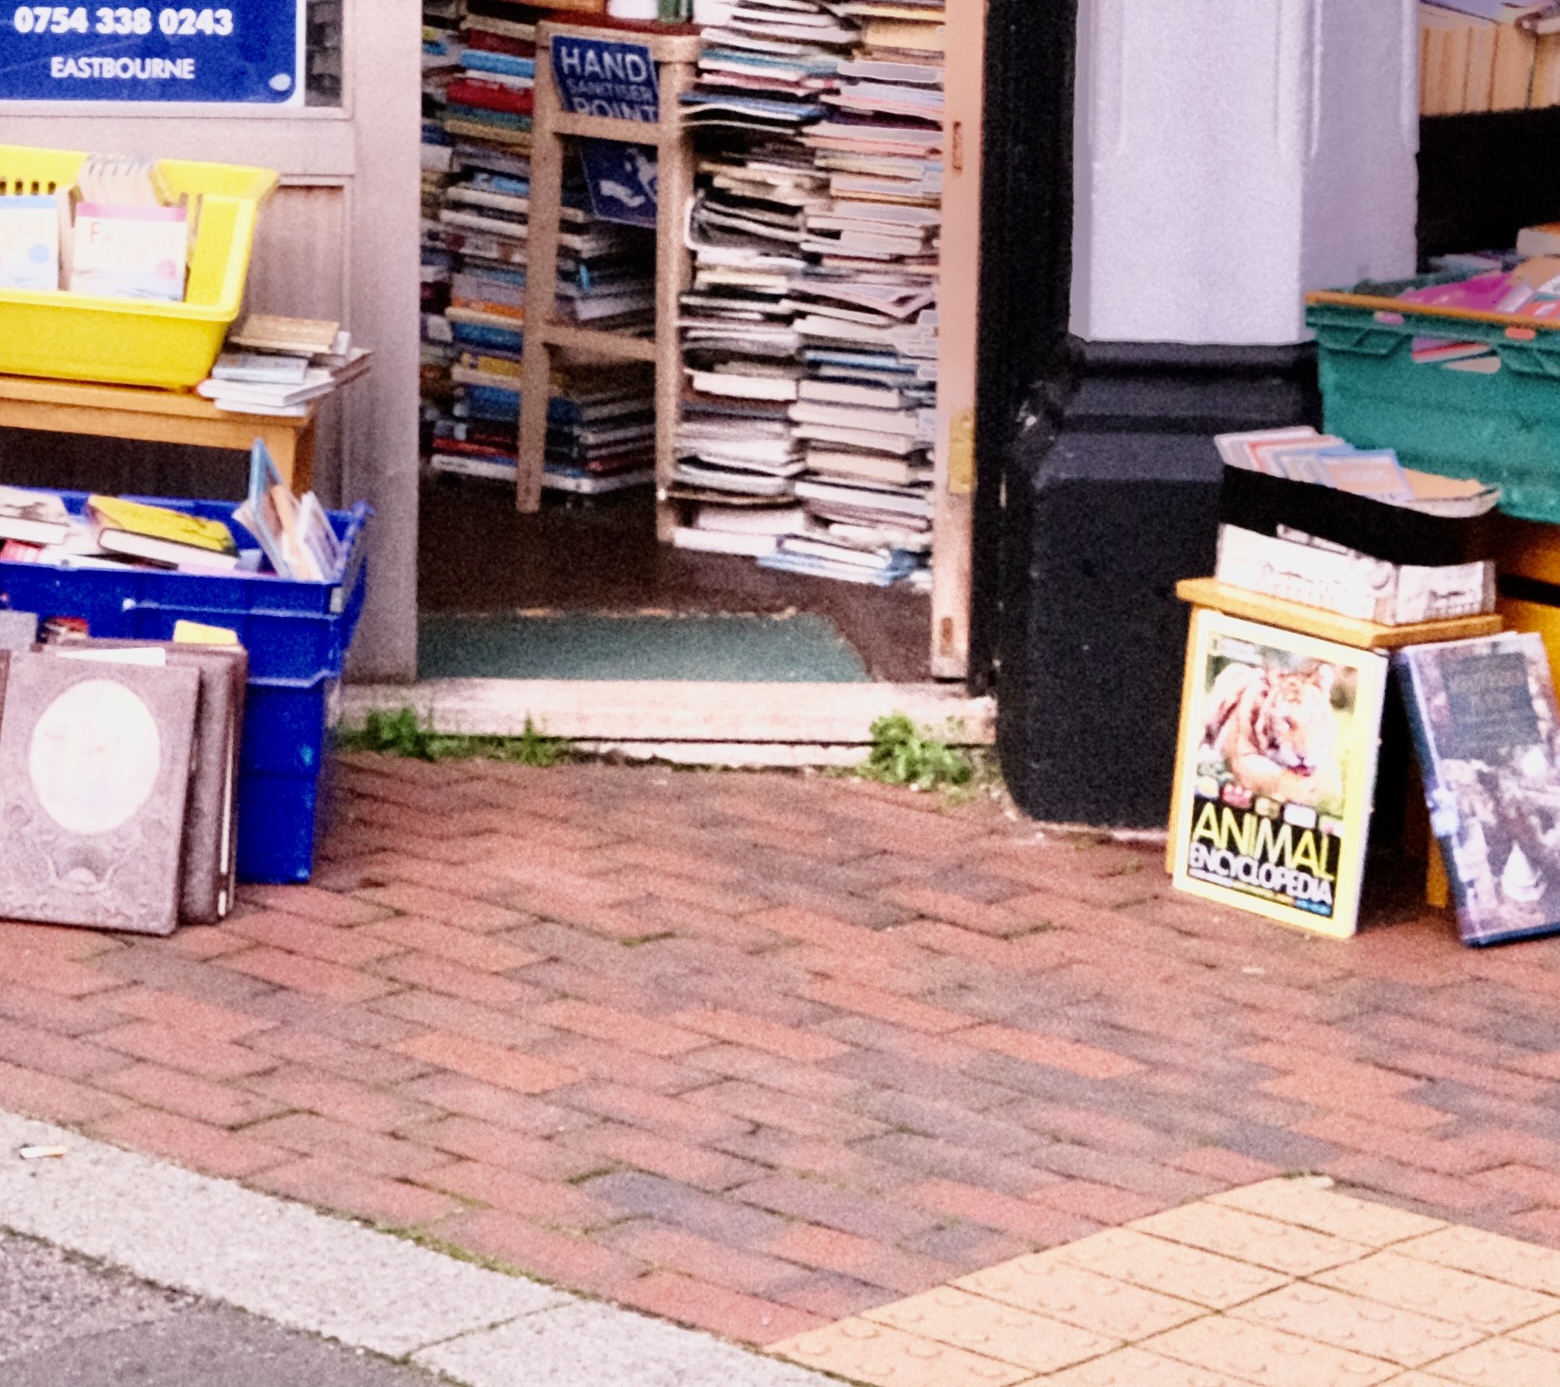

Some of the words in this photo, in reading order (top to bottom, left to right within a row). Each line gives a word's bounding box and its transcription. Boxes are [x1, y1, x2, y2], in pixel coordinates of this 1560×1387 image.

[14, 6, 88, 34] 0754
[95, 7, 152, 35] 338
[158, 8, 234, 36] 0243
[51, 57, 195, 80] EASTBOURNE
[560, 45, 648, 83] HAND
[1192, 801, 1336, 881] ANIMAL
[1189, 841, 1334, 906] ENCYCLOPEDIA
